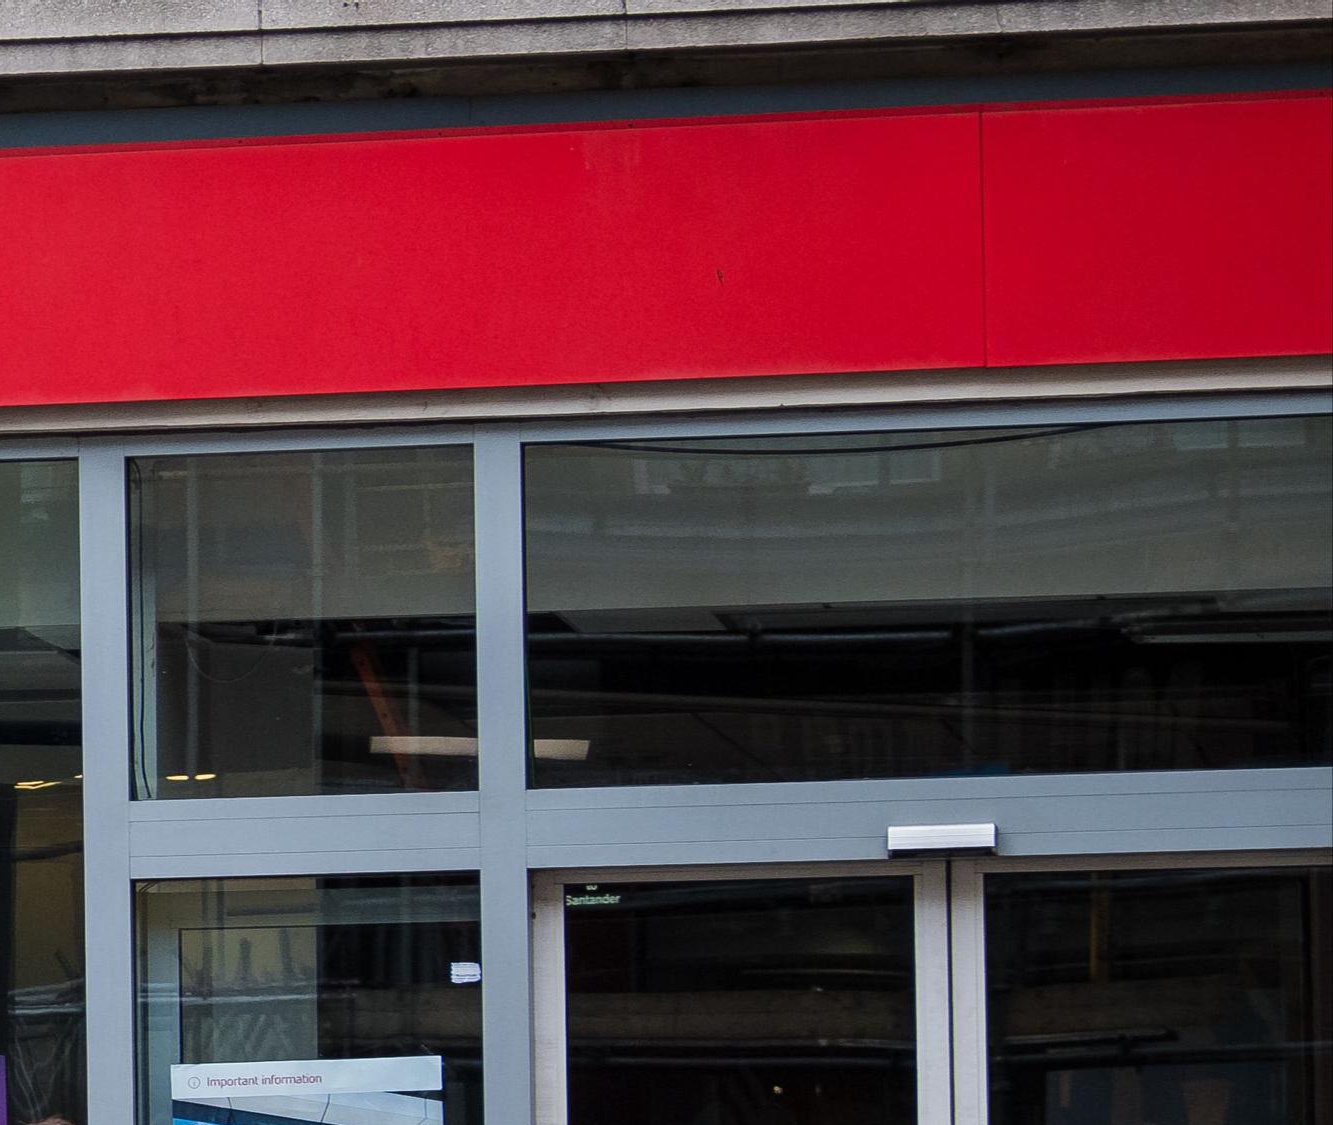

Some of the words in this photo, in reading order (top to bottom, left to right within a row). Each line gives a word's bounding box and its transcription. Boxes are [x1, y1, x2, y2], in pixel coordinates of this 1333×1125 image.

[565, 893, 621, 906] Santander
[206, 1075, 258, 1088] Important
[261, 1073, 322, 1086] information
